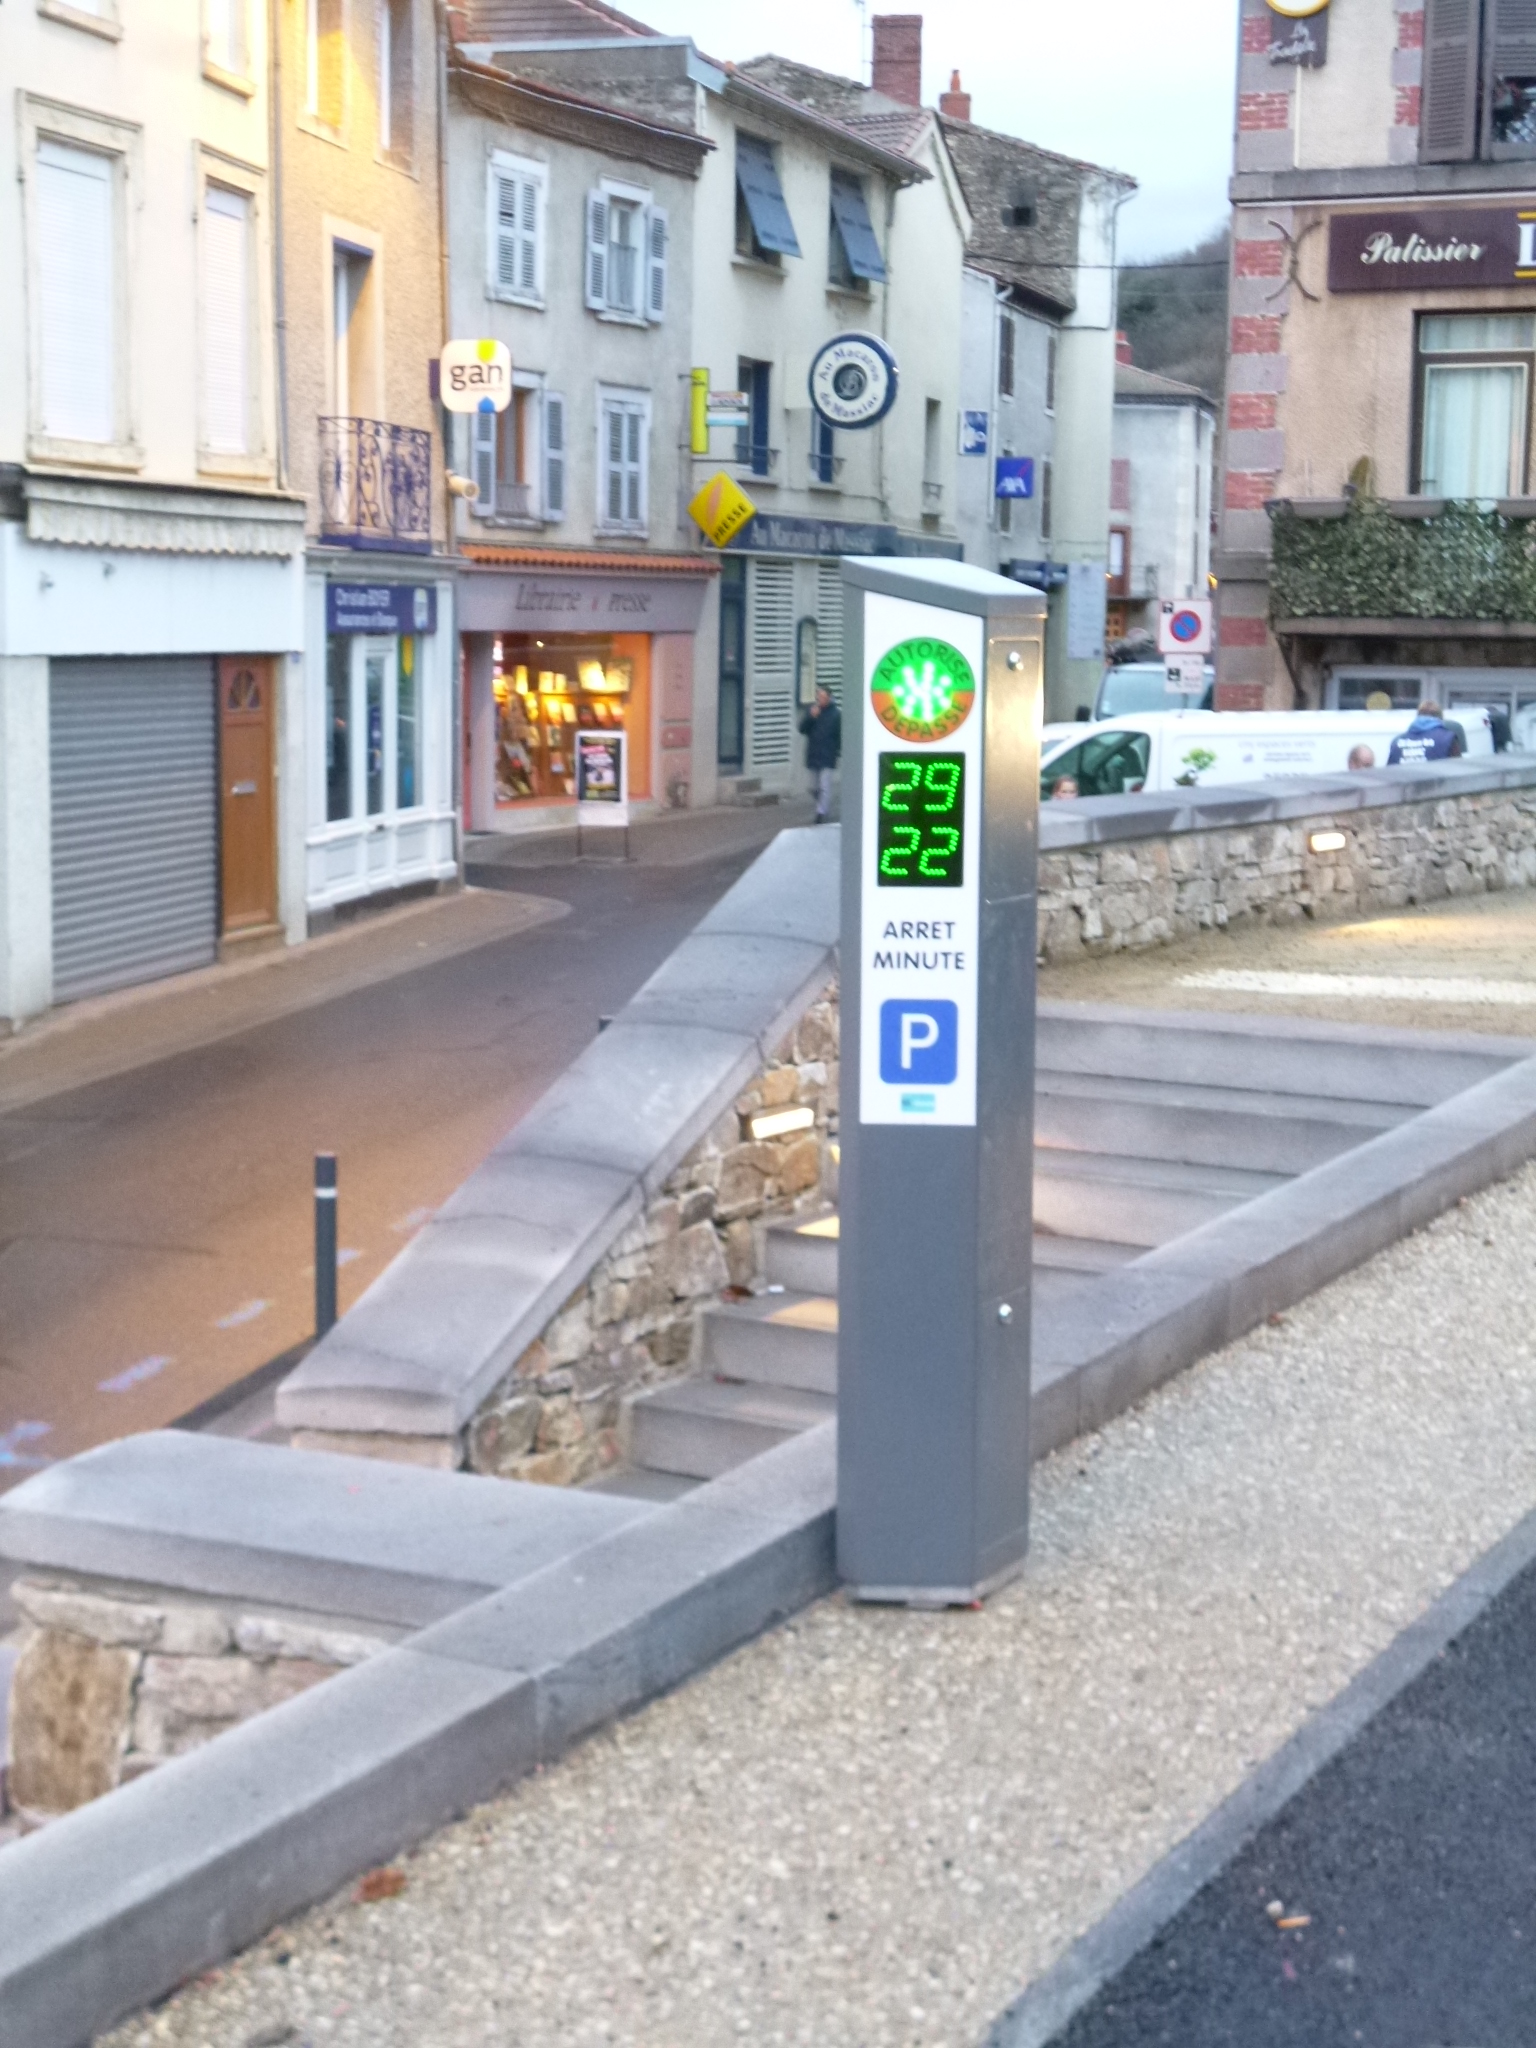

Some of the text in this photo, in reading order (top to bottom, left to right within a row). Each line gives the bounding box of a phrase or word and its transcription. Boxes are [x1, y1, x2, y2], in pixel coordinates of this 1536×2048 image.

[450, 364, 503, 391] gan
[833, 347, 879, 382] Macaron
[996, 476, 1027, 494] AXA
[713, 502, 746, 541] PRESSE
[879, 641, 970, 683] AUTORISE
[881, 761, 961, 812] 29
[881, 826, 960, 876] 22
[883, 920, 956, 940] ARRET
[873, 951, 965, 970] MINUTE
[902, 1013, 939, 1069] P
